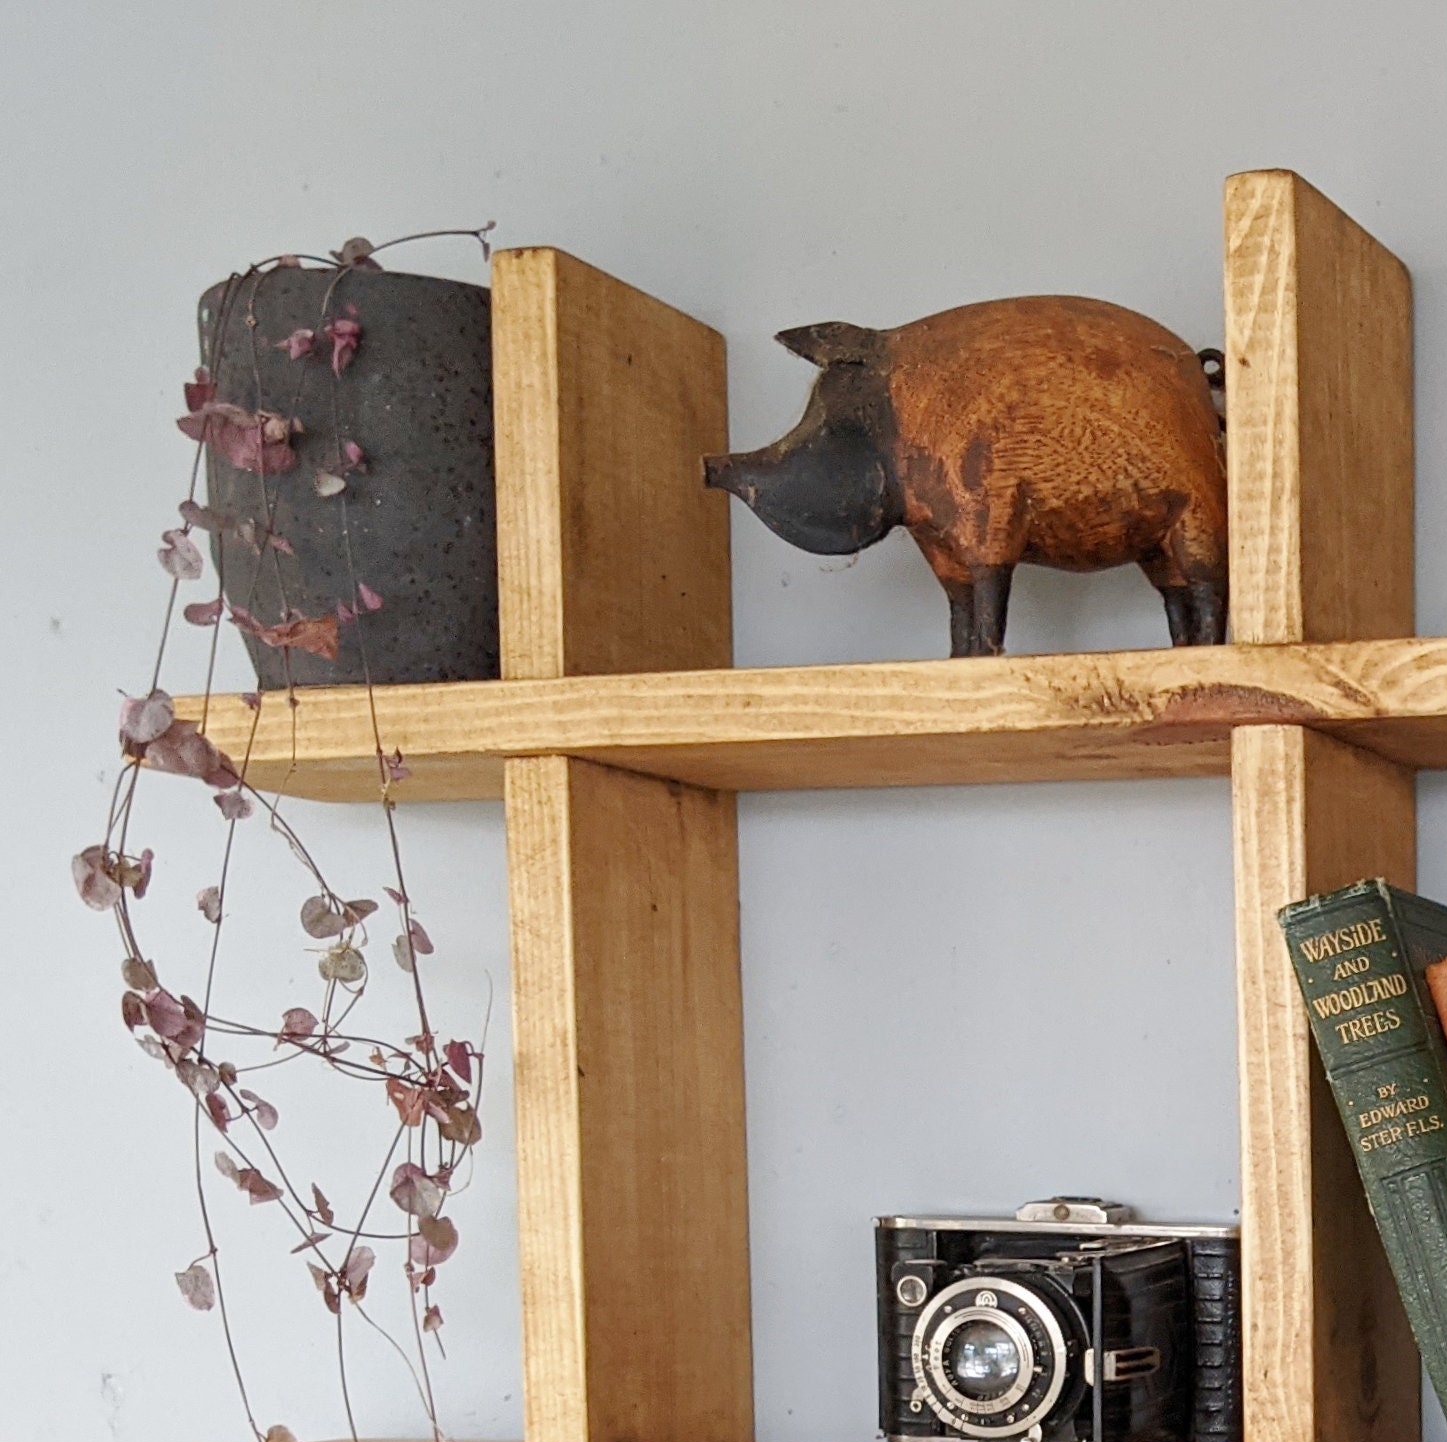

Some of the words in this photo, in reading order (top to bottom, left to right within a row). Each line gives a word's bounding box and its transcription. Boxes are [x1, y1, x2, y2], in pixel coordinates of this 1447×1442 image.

[1333, 956, 1370, 981] AND
[1312, 973, 1408, 1020] WOODLAND
[1335, 1008, 1401, 1045] TREES
[1377, 1083, 1397, 1099] BY
[1359, 1095, 1429, 1128] EDWARD
